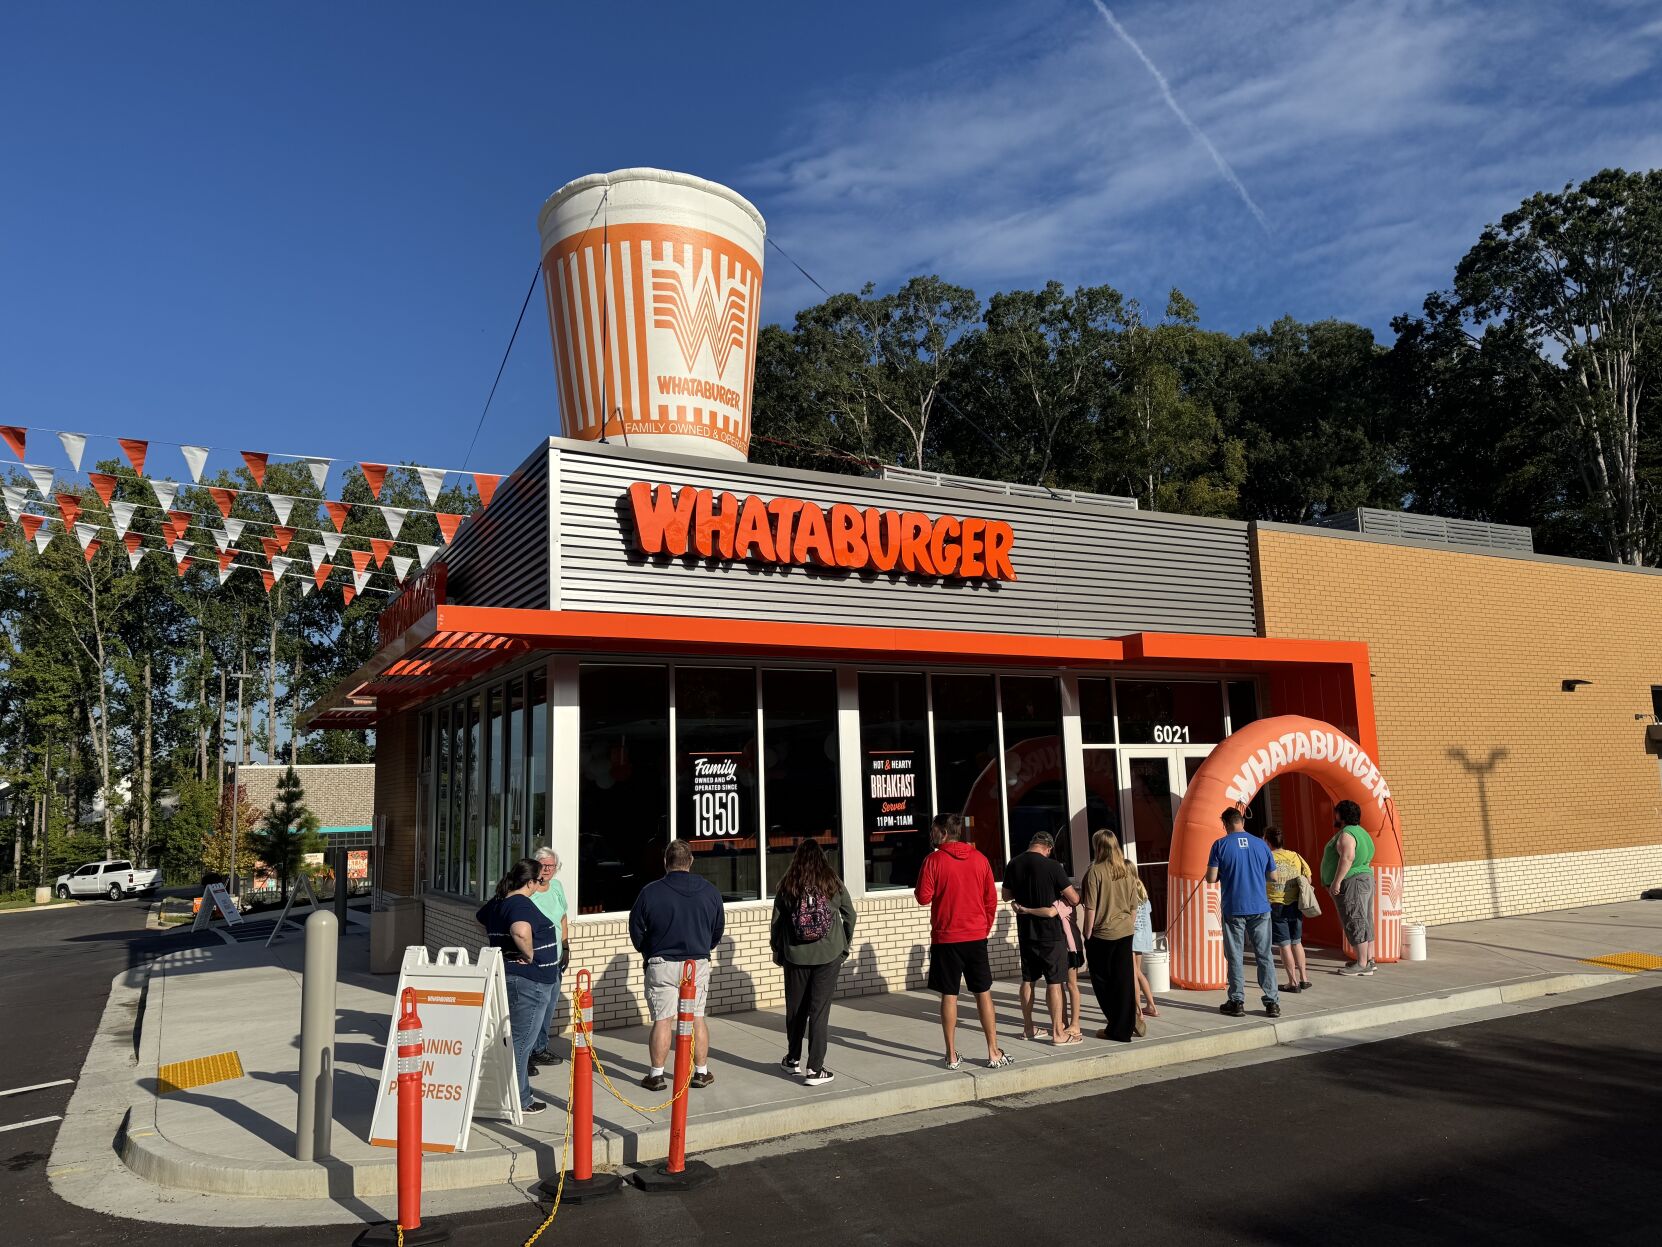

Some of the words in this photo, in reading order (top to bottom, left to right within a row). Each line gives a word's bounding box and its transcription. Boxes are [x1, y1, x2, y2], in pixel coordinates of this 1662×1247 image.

[657, 376, 741, 412] WHATABURGER
[625, 423, 666, 433] FAMILY
[669, 423, 710, 437] OWNED
[712, 429, 719, 439] &
[627, 482, 1018, 582] WHATABURGER
[1154, 725, 1190, 743] 6021
[694, 758, 737, 781] Family
[873, 760, 884, 769] HOT
[885, 759, 891, 770] &
[892, 760, 912, 769] HEARTY
[1226, 729, 1391, 808] WHATABURGER
[871, 774, 915, 798] BREAKFAST
[692, 792, 740, 836] 1950
[881, 799, 907, 813] Served
[877, 815, 913, 827] 11PM-11AM
[387, 1080, 463, 1101] PGRESS
